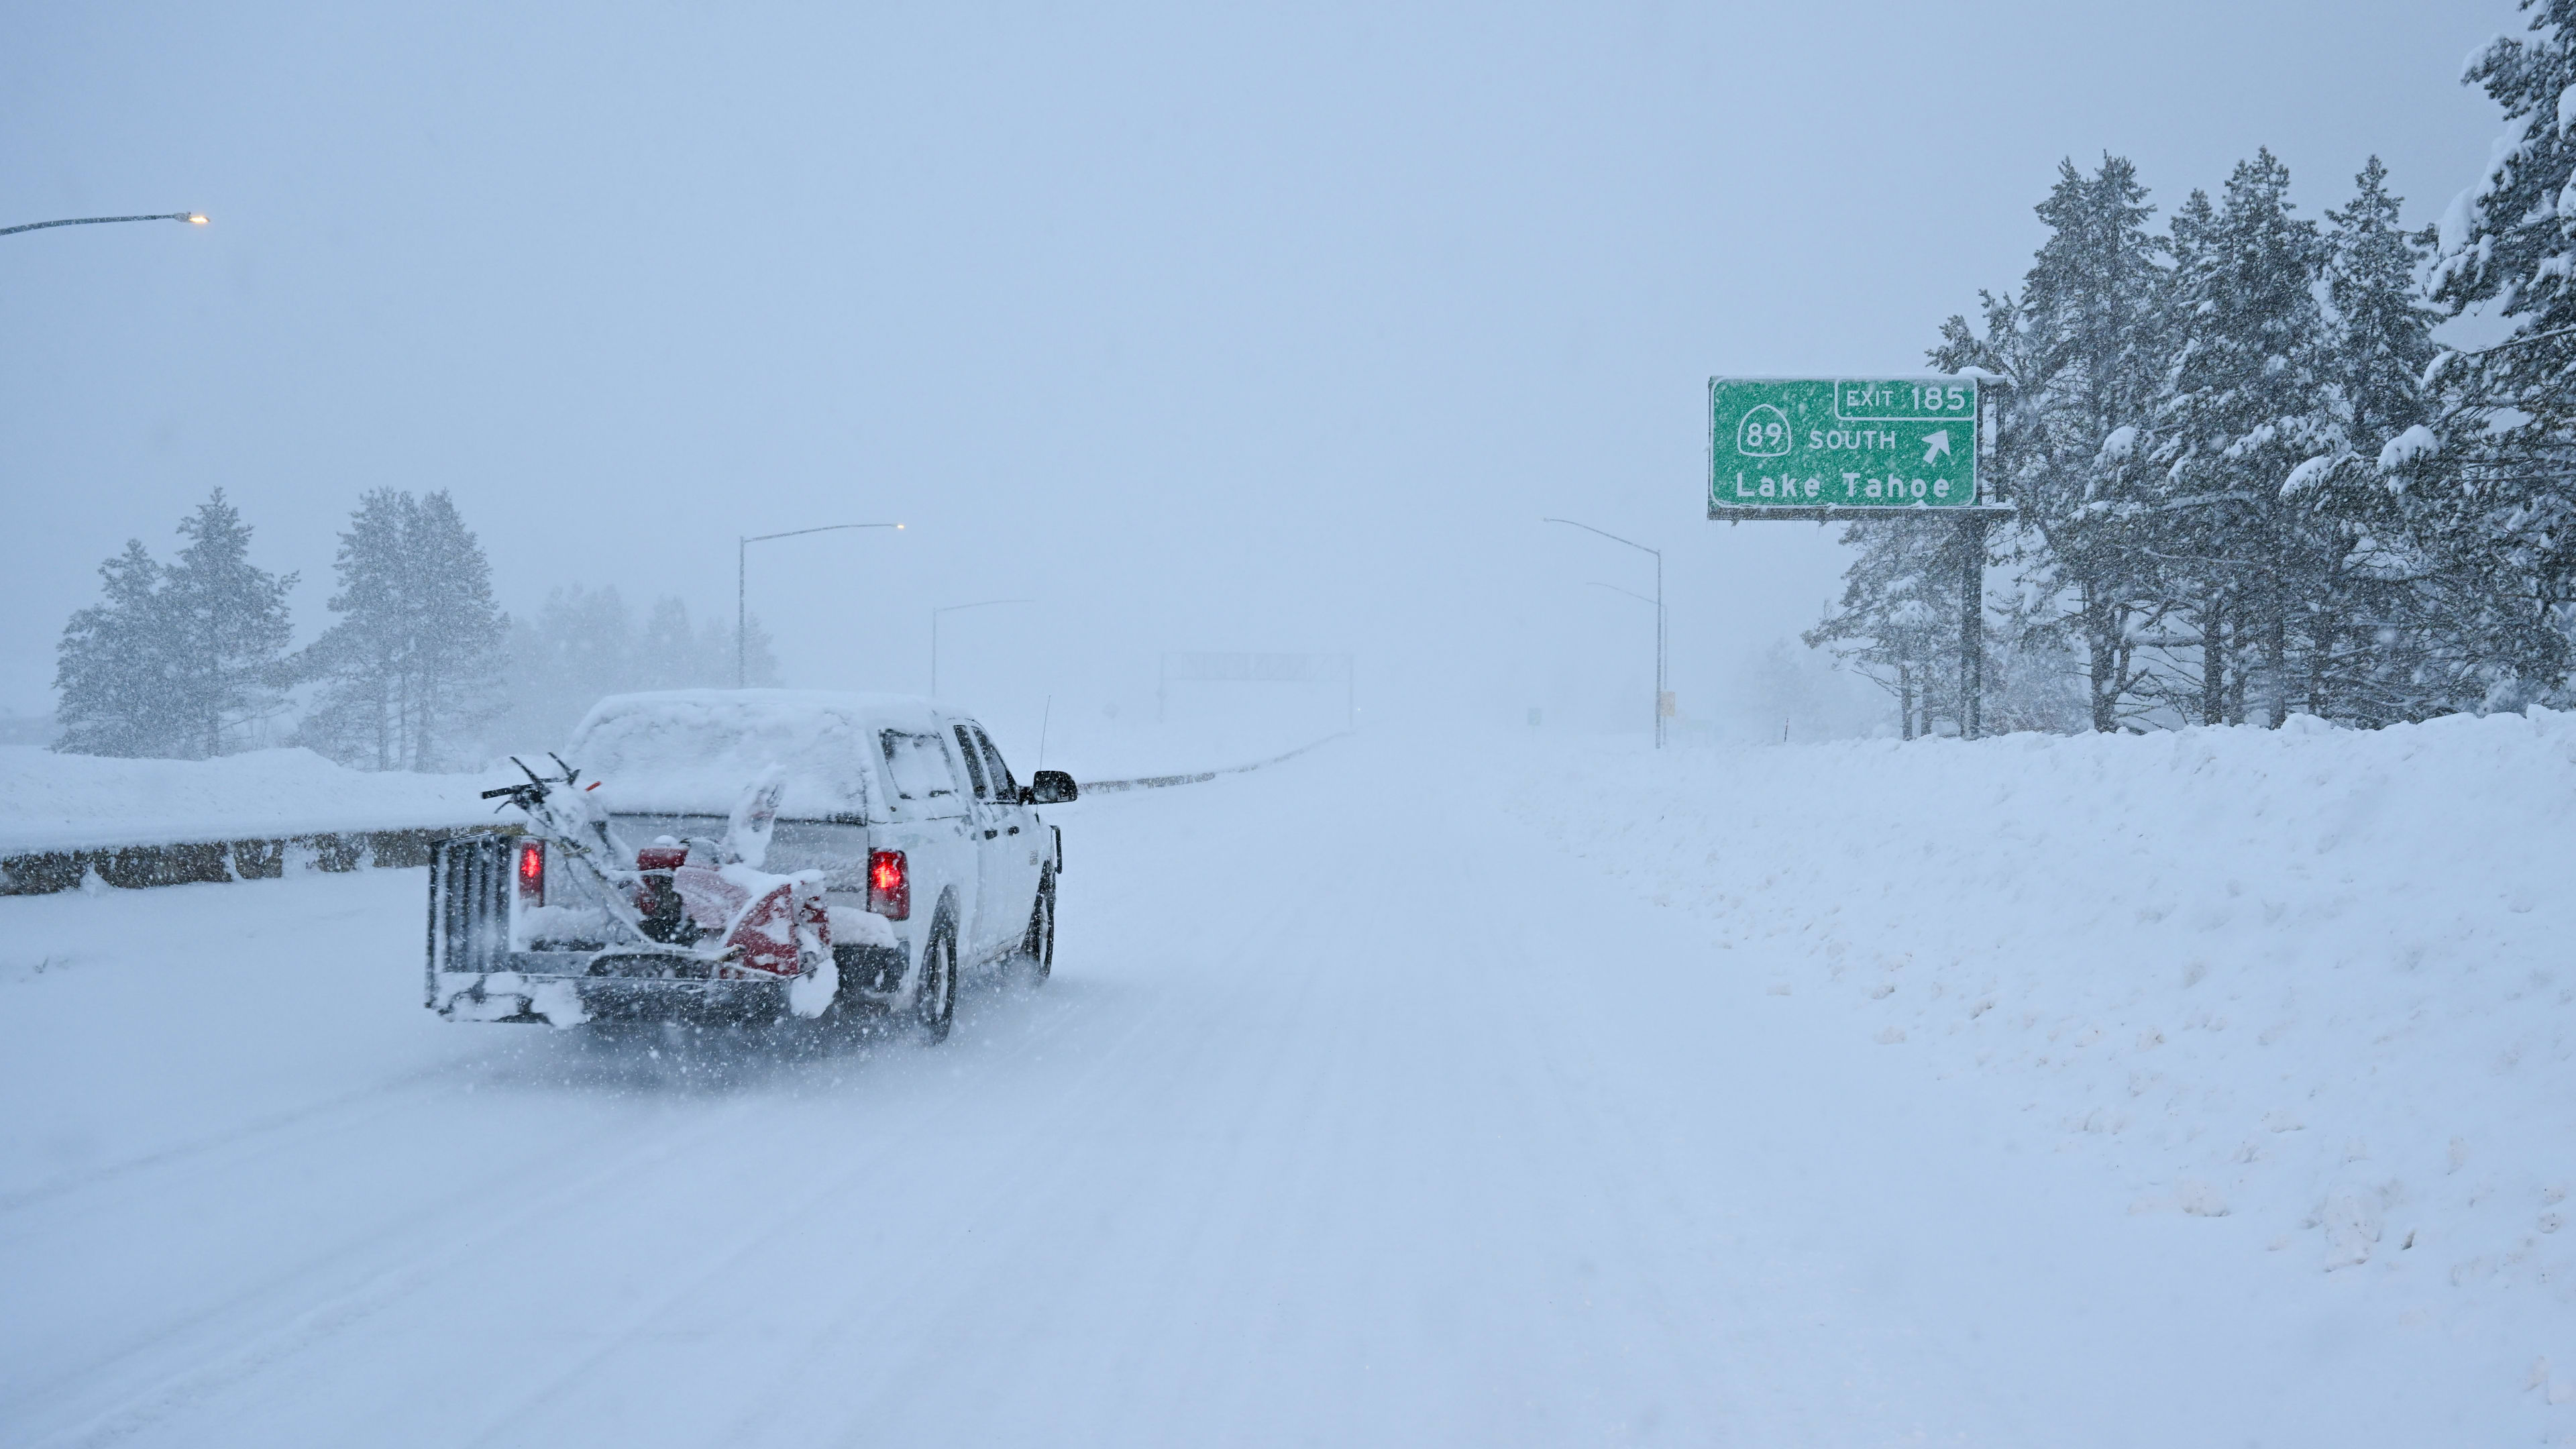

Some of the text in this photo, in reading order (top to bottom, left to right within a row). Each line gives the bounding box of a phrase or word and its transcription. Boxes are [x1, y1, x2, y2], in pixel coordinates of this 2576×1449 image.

[1847, 387, 1966, 411] EXIT 185
[1747, 423, 1782, 447] 89
[1809, 430, 1896, 449] SOUTH
[1737, 472, 1950, 498] Lake Tahoe
